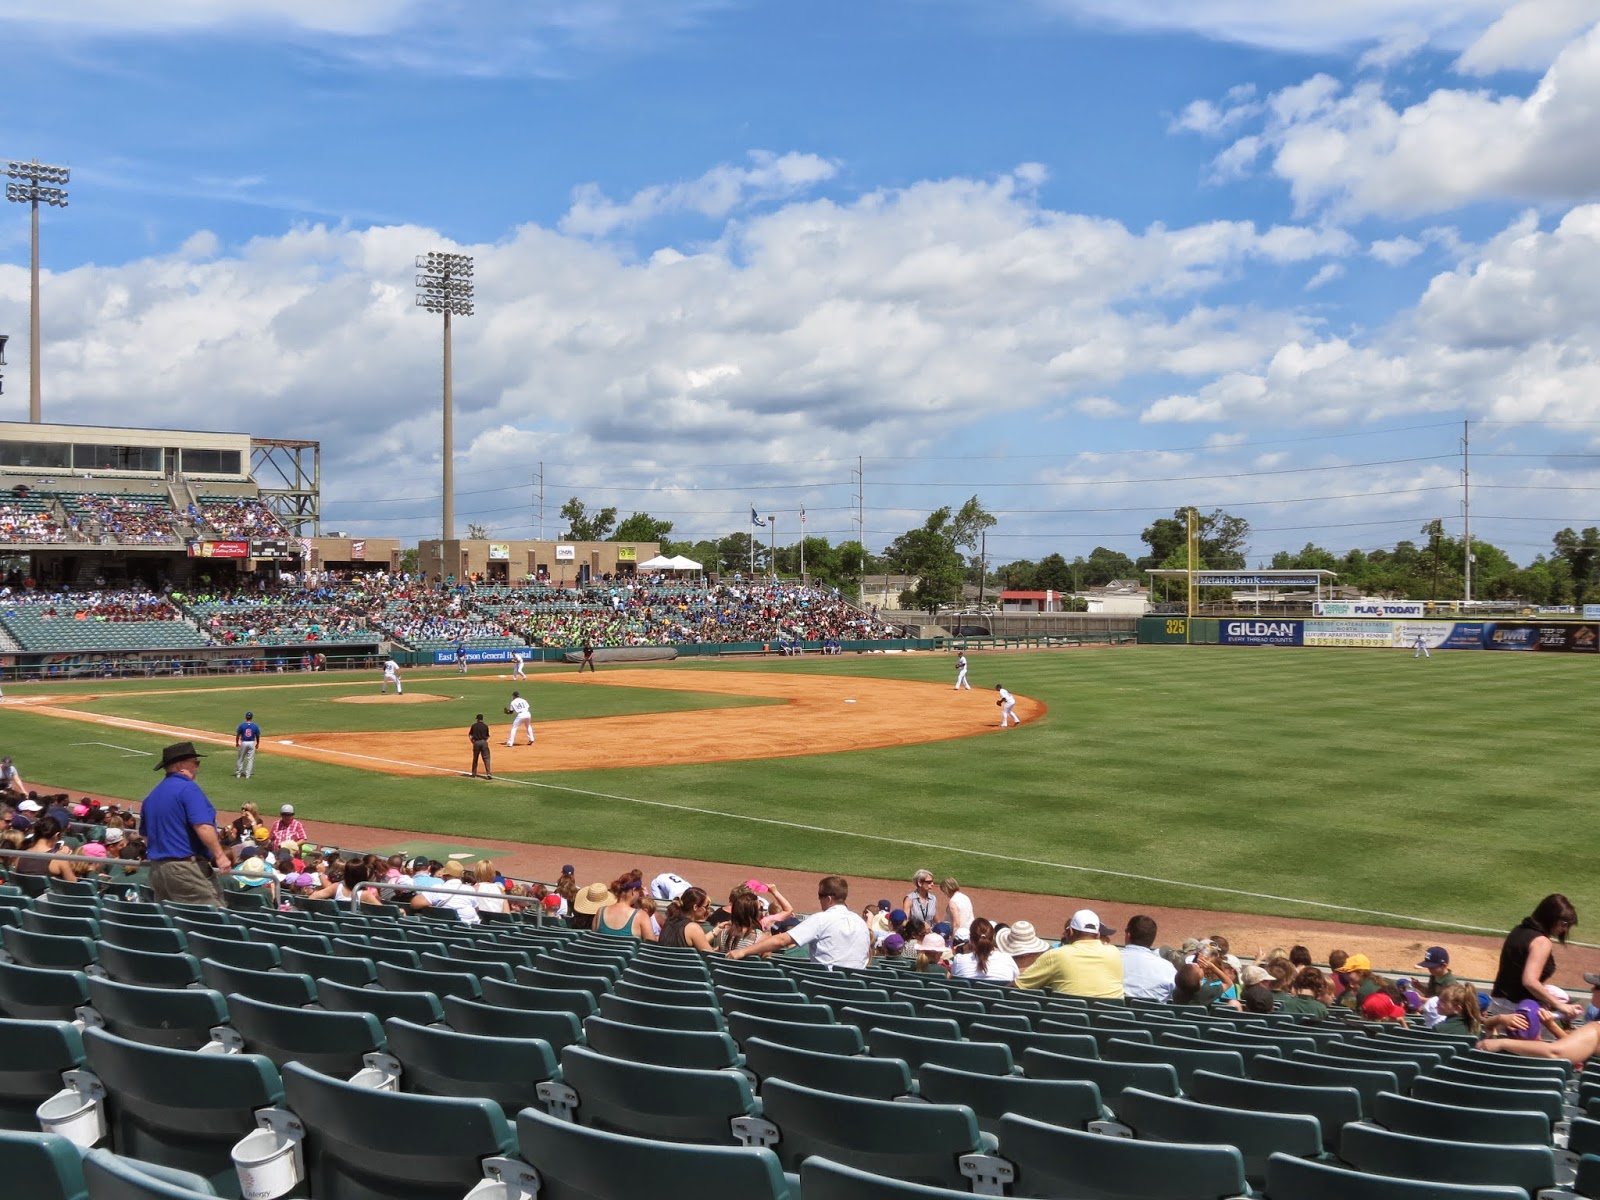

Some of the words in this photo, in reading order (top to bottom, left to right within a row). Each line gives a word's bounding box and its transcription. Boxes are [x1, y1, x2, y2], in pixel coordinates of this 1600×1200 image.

[1354, 606, 1380, 614] PLAY
[1382, 606, 1420, 614] TODAY!
[1166, 619, 1185, 634] 325
[1227, 622, 1294, 636] GILDAN
[1310, 638, 1385, 646] 855-848-1993
[438, 653, 452, 661] East
[481, 652, 506, 660] General
